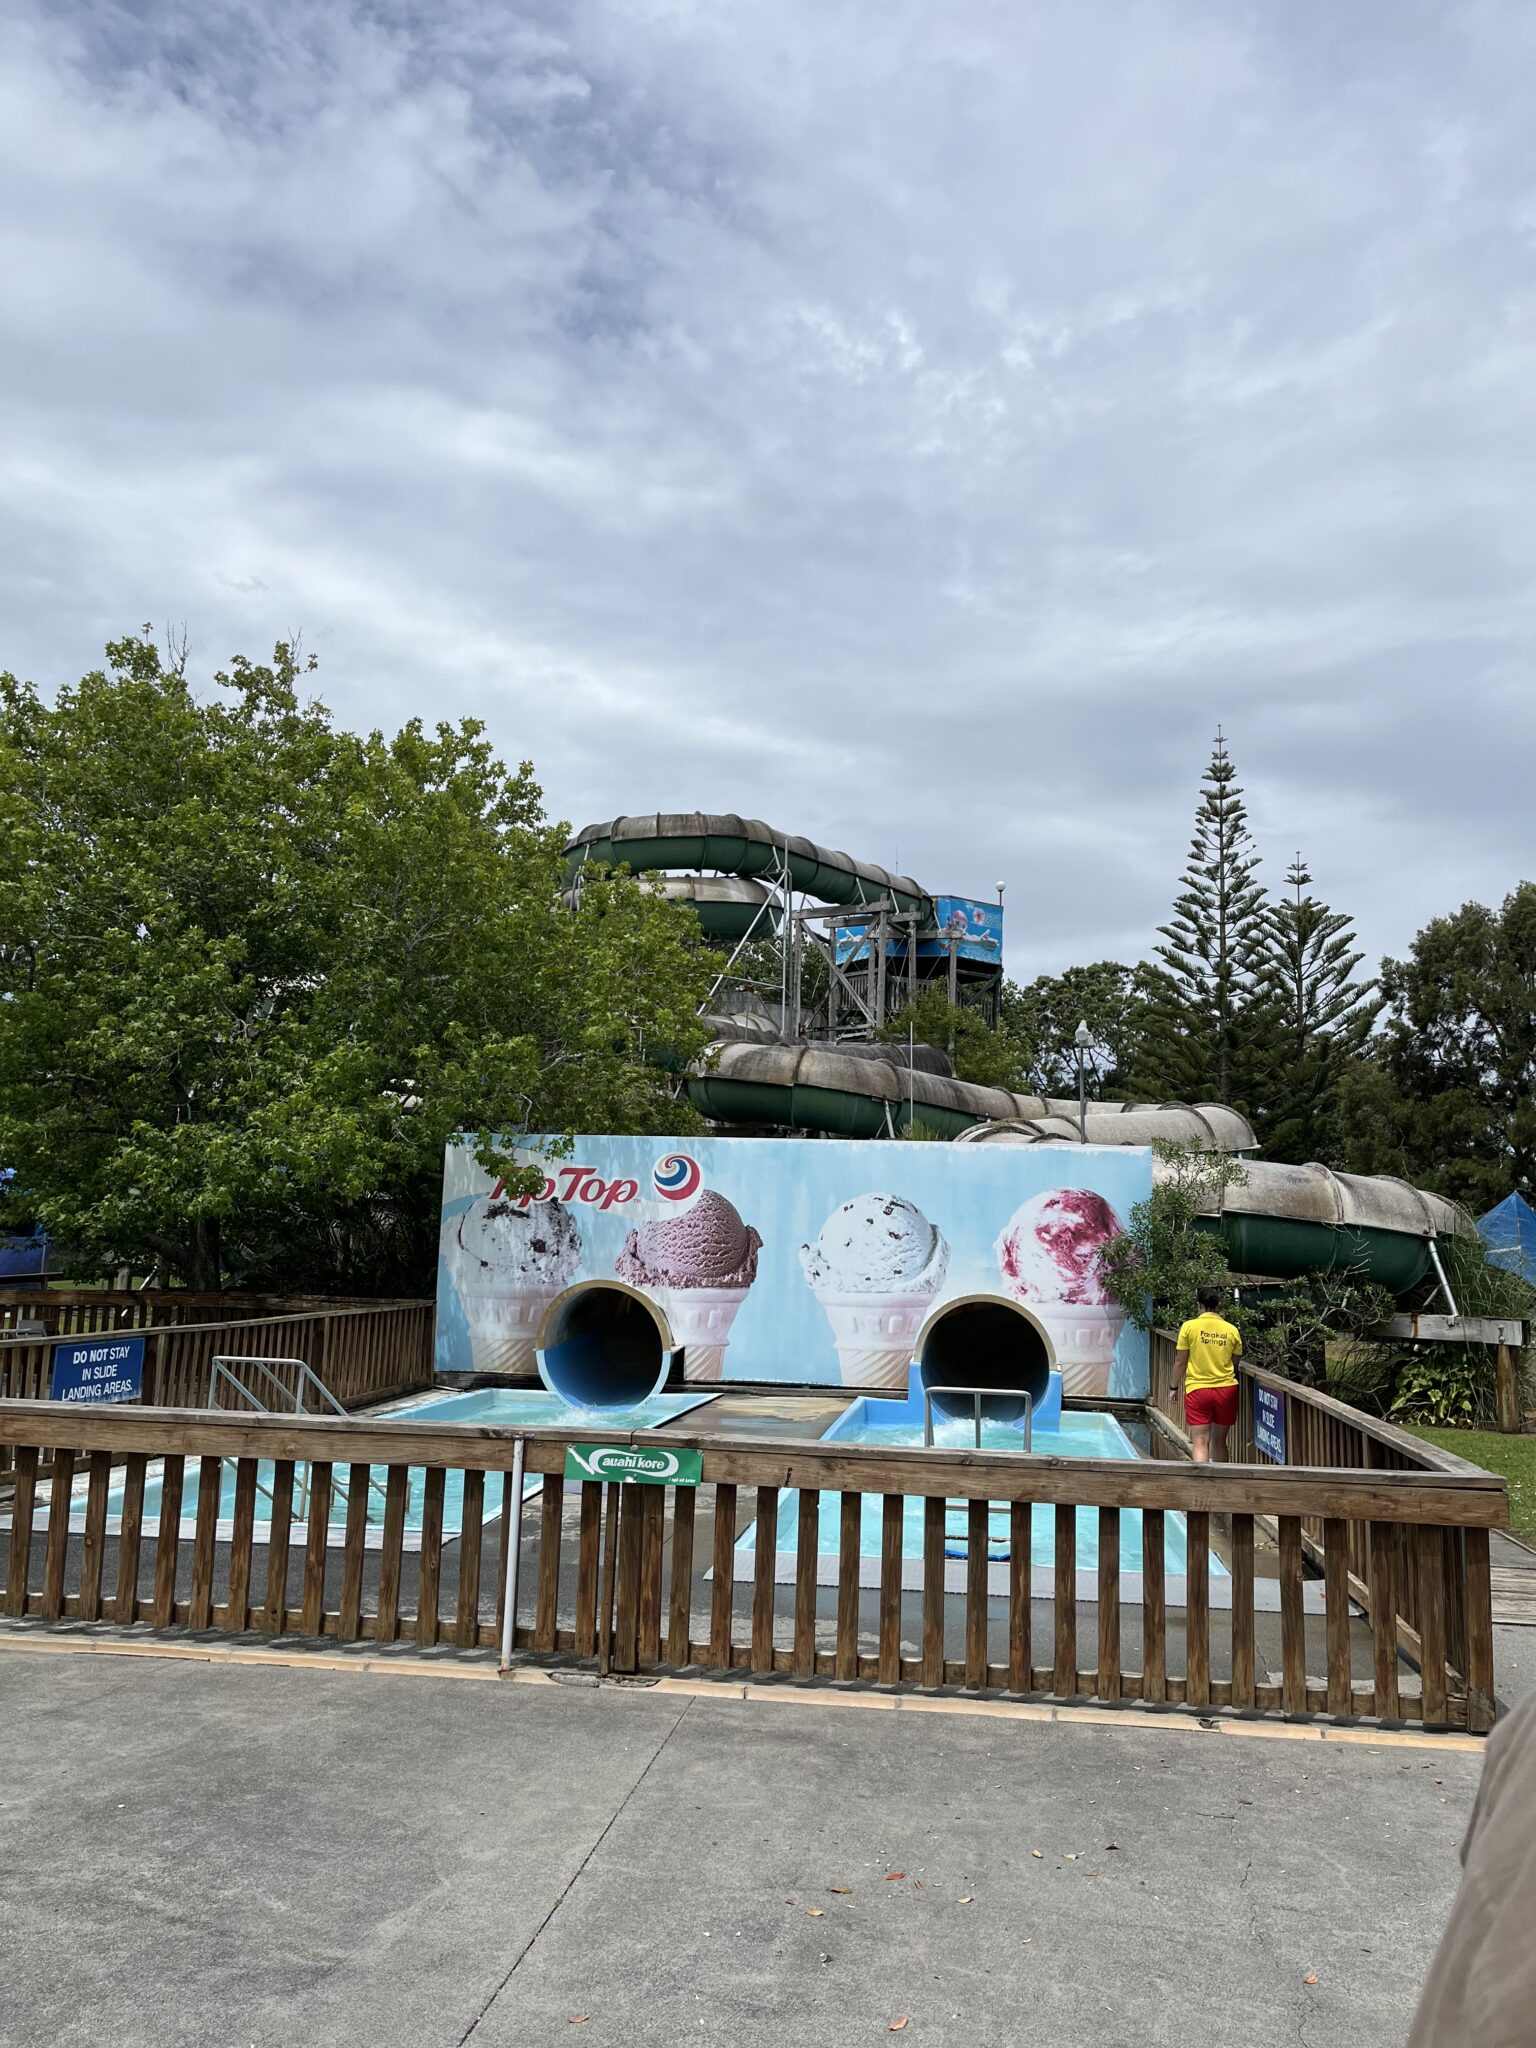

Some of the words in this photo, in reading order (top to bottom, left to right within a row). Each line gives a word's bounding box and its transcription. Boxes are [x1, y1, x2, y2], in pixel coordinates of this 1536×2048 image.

[558, 1167, 639, 1210] Top
[1200, 1336, 1227, 1347] Springs
[73, 1350, 88, 1365] DO
[89, 1348, 109, 1363] NOT
[109, 1345, 131, 1360] STAY
[81, 1367, 92, 1381] IN
[93, 1364, 118, 1380] SLIDE
[61, 1384, 102, 1402] LANDING
[103, 1378, 133, 1396] AREAS.
[602, 1456, 636, 1468] auahi
[637, 1457, 665, 1470] kore
